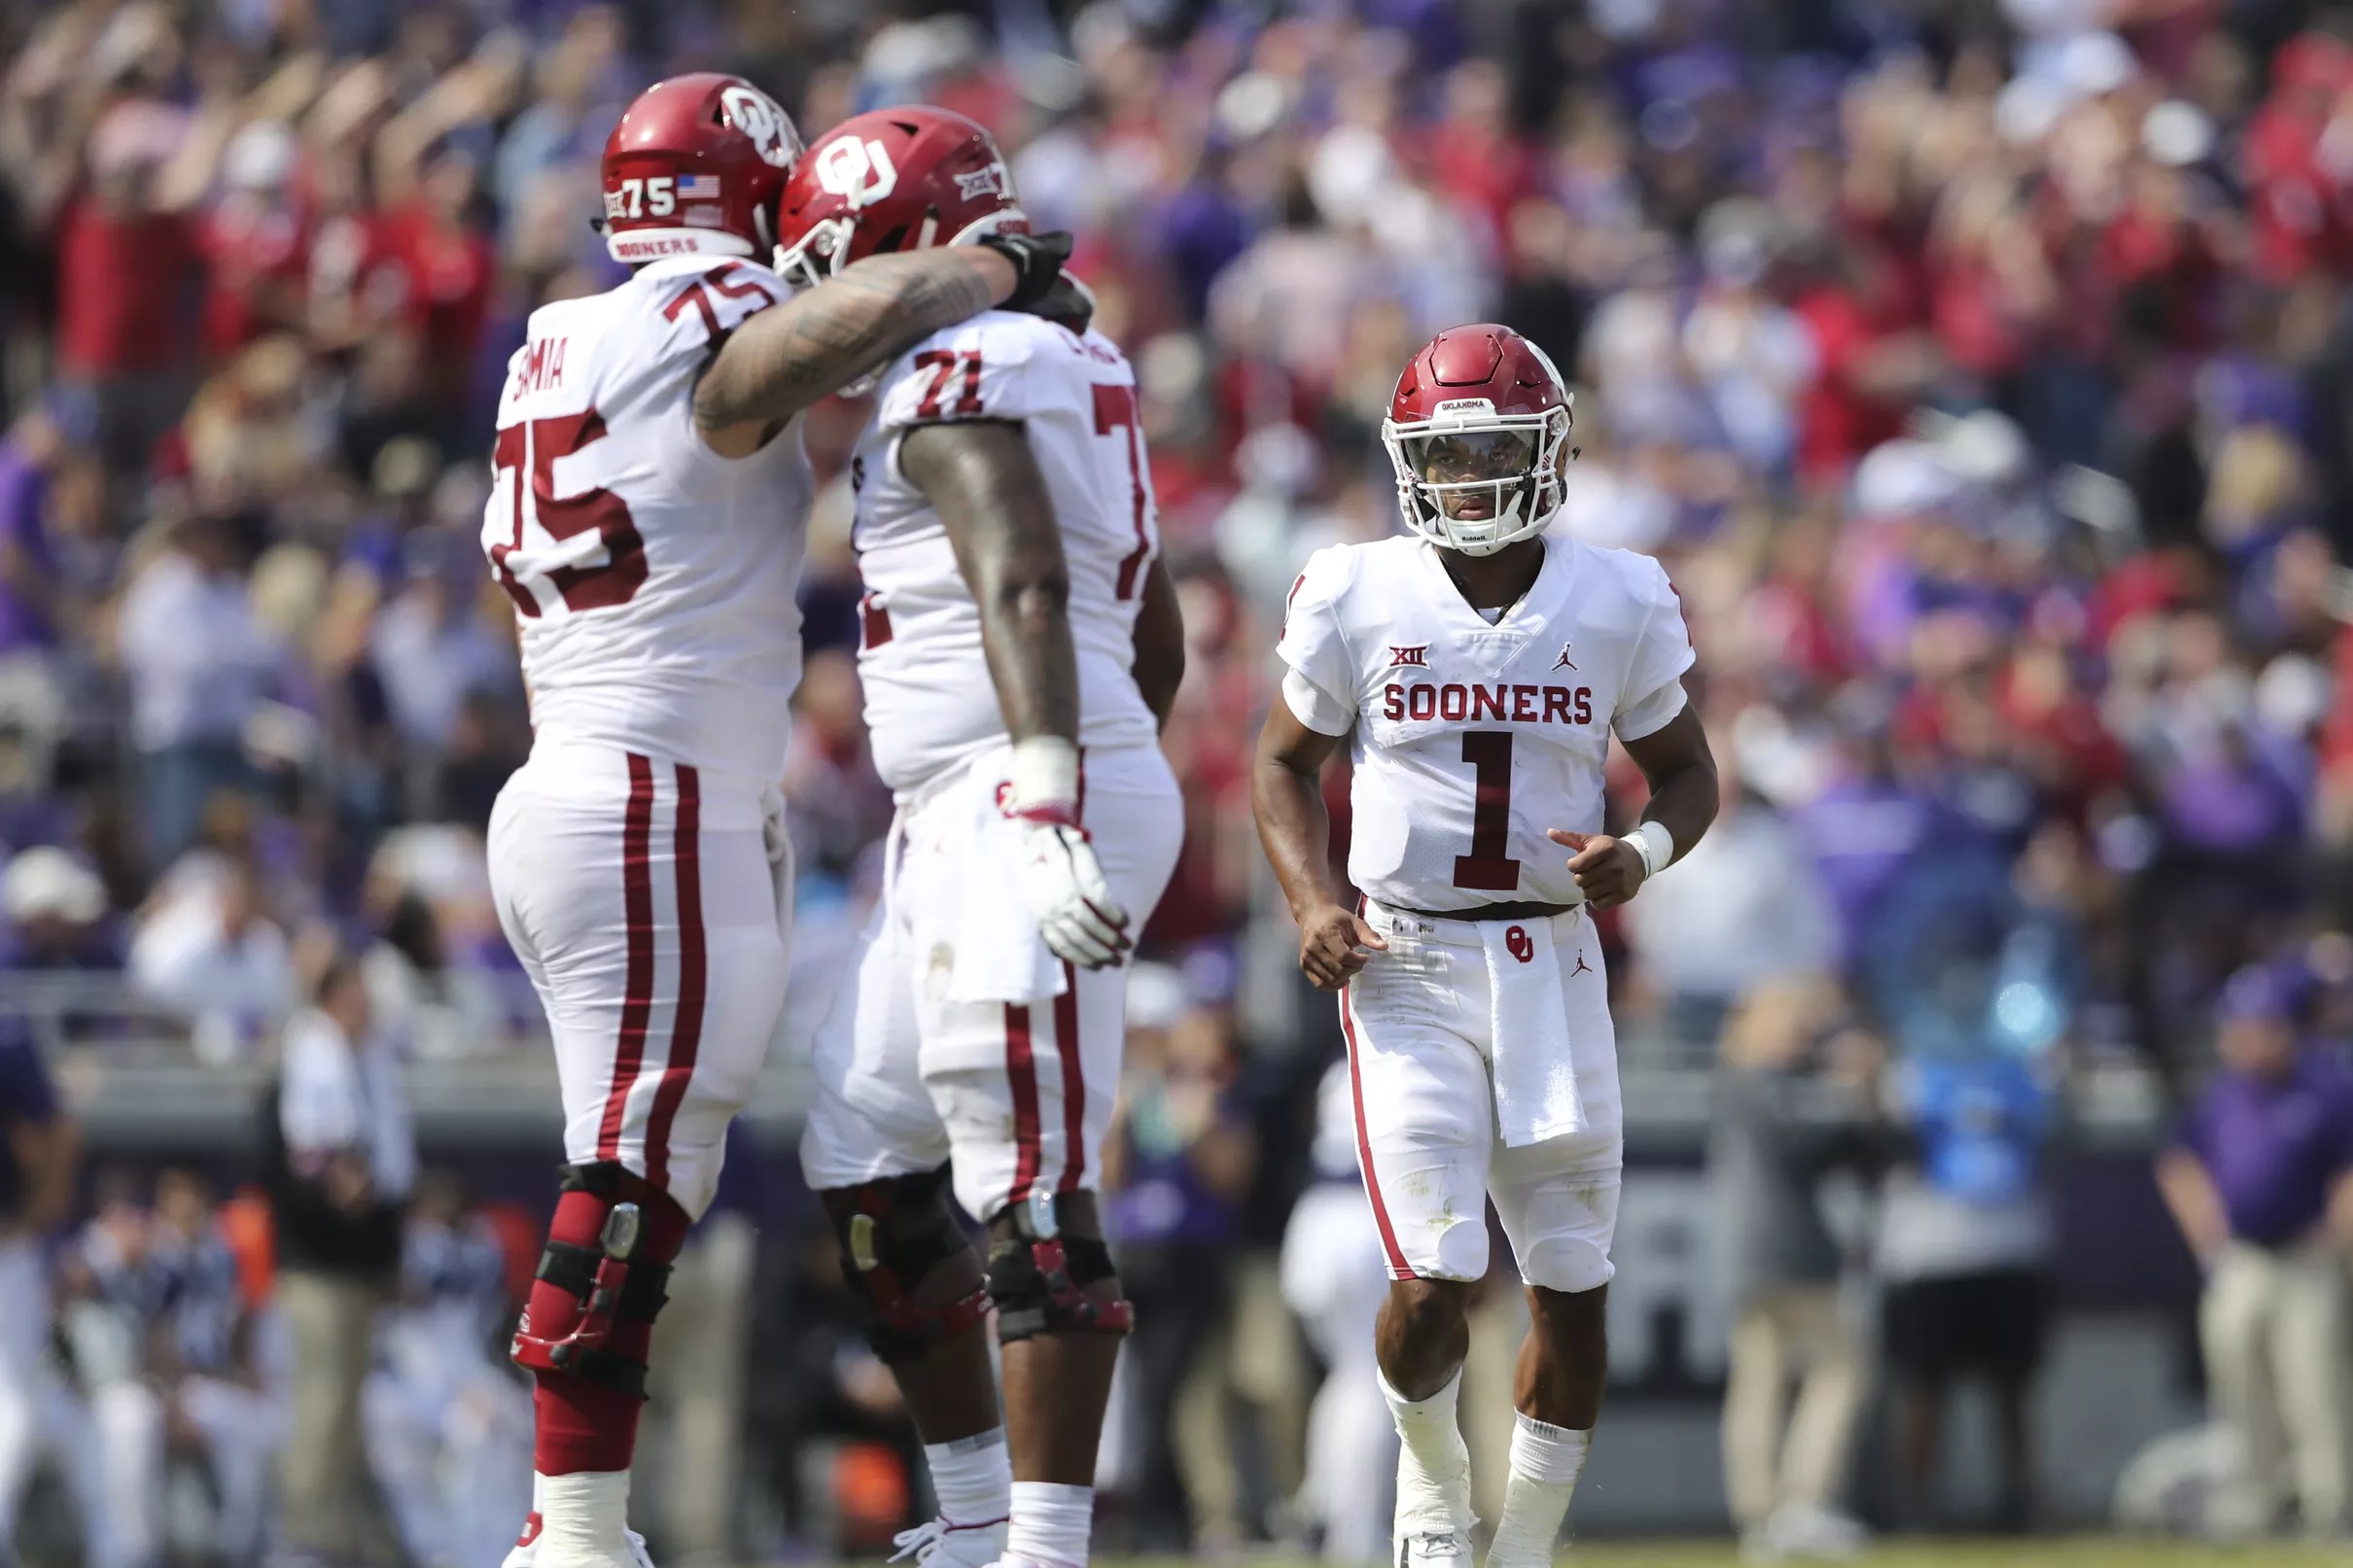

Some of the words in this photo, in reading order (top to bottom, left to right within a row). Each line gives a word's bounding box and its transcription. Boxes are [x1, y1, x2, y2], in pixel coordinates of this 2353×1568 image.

[621, 177, 675, 219] 75
[816, 135, 897, 210] OU
[915, 350, 983, 417] 71
[1441, 400, 1485, 411] OKLAHOMA
[491, 406, 650, 618] 75
[1384, 683, 1592, 725] SOONERS
[1453, 731, 1520, 890] 1
[1505, 924, 1533, 963] OU
